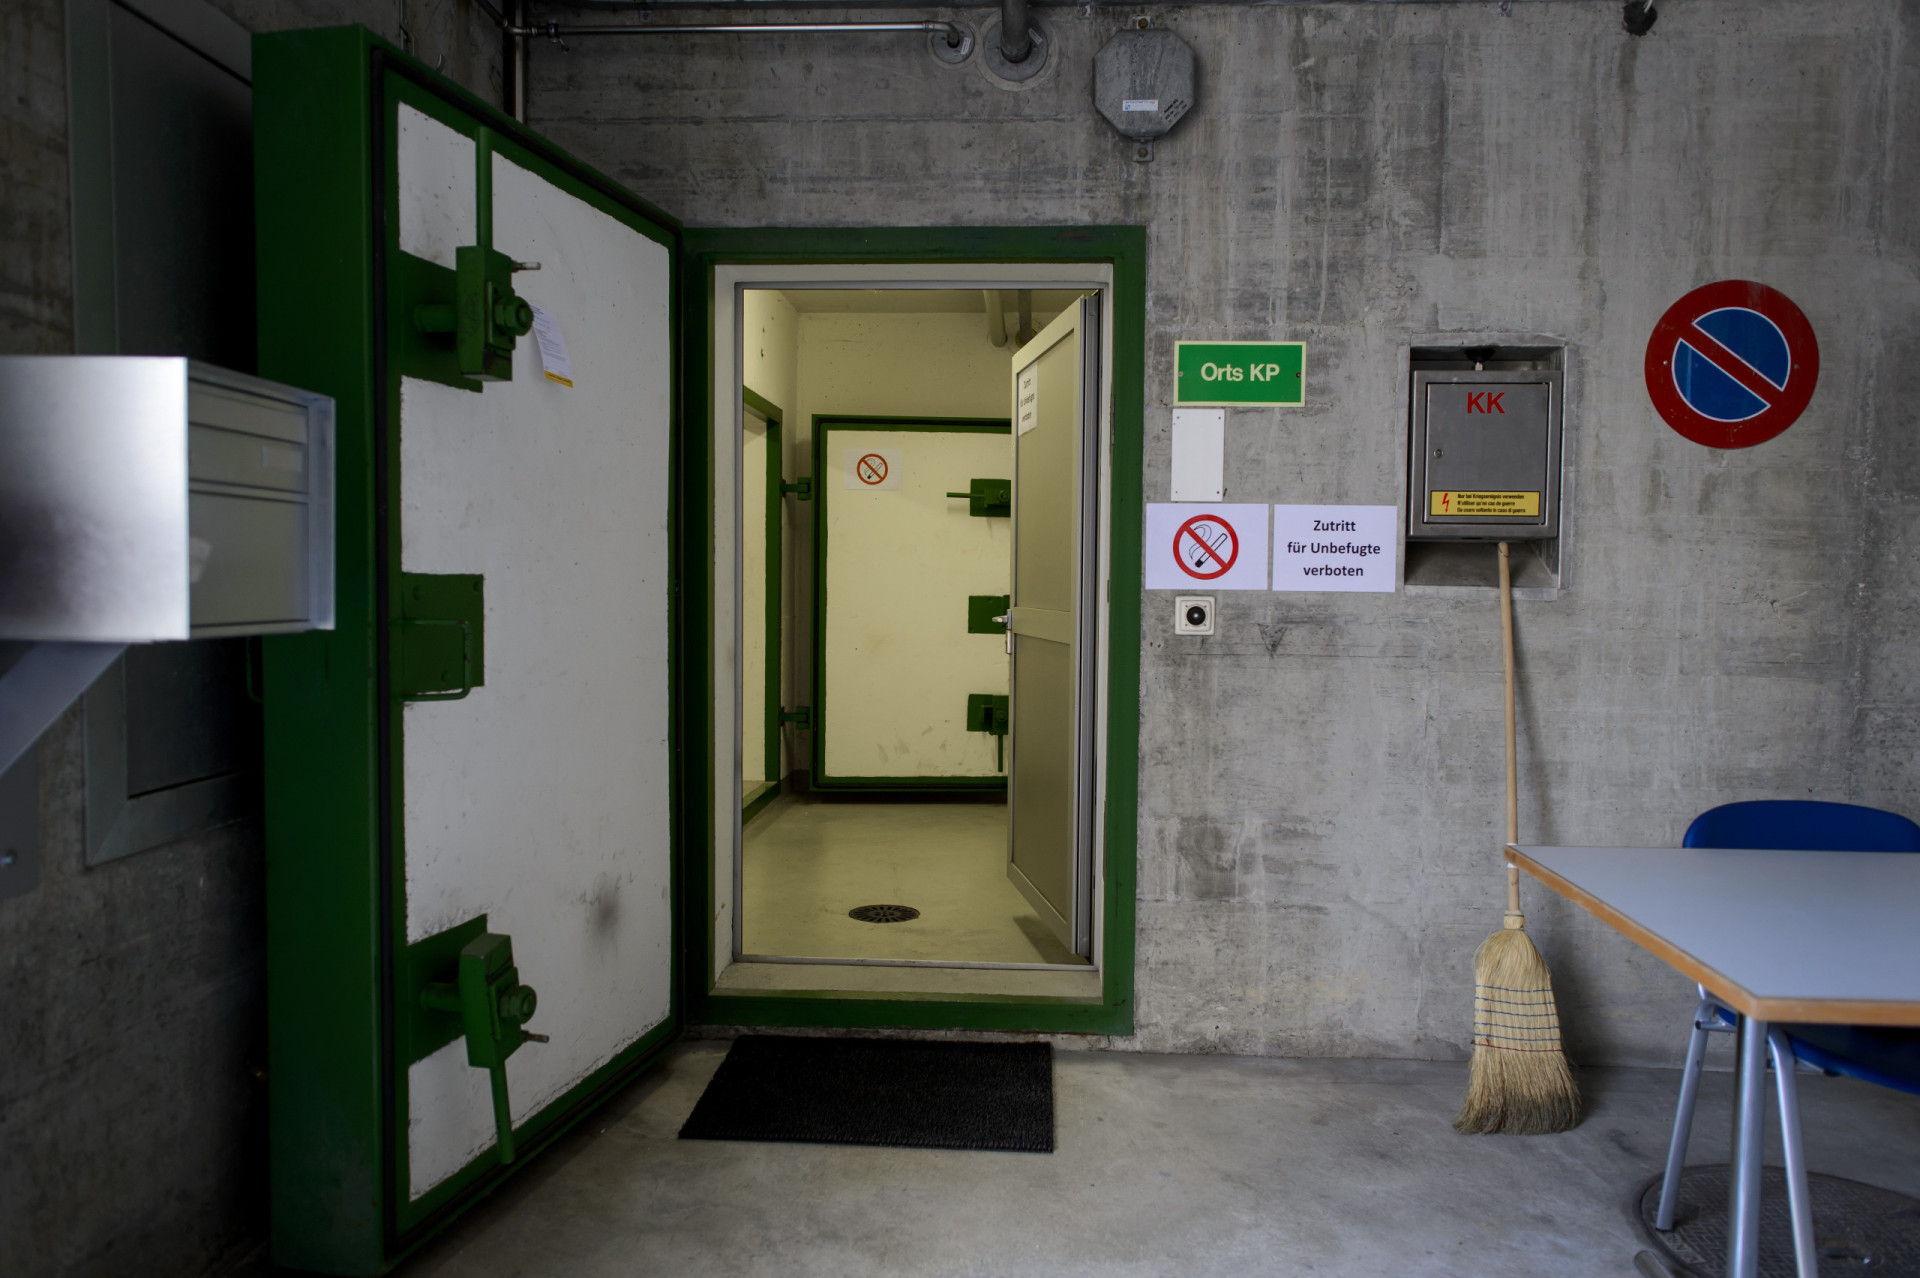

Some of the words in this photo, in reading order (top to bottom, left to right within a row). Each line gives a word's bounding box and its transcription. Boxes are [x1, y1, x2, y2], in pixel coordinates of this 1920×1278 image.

[1200, 362, 1244, 382] Orts
[1250, 363, 1280, 382] KP
[1467, 391, 1505, 414] KK
[1473, 493, 1502, 501] Kriegsereignis
[1313, 519, 1357, 532] Zutritt
[1287, 541, 1307, 556] für
[1310, 541, 1381, 558] Unbefugte
[1303, 564, 1364, 578] verboten
